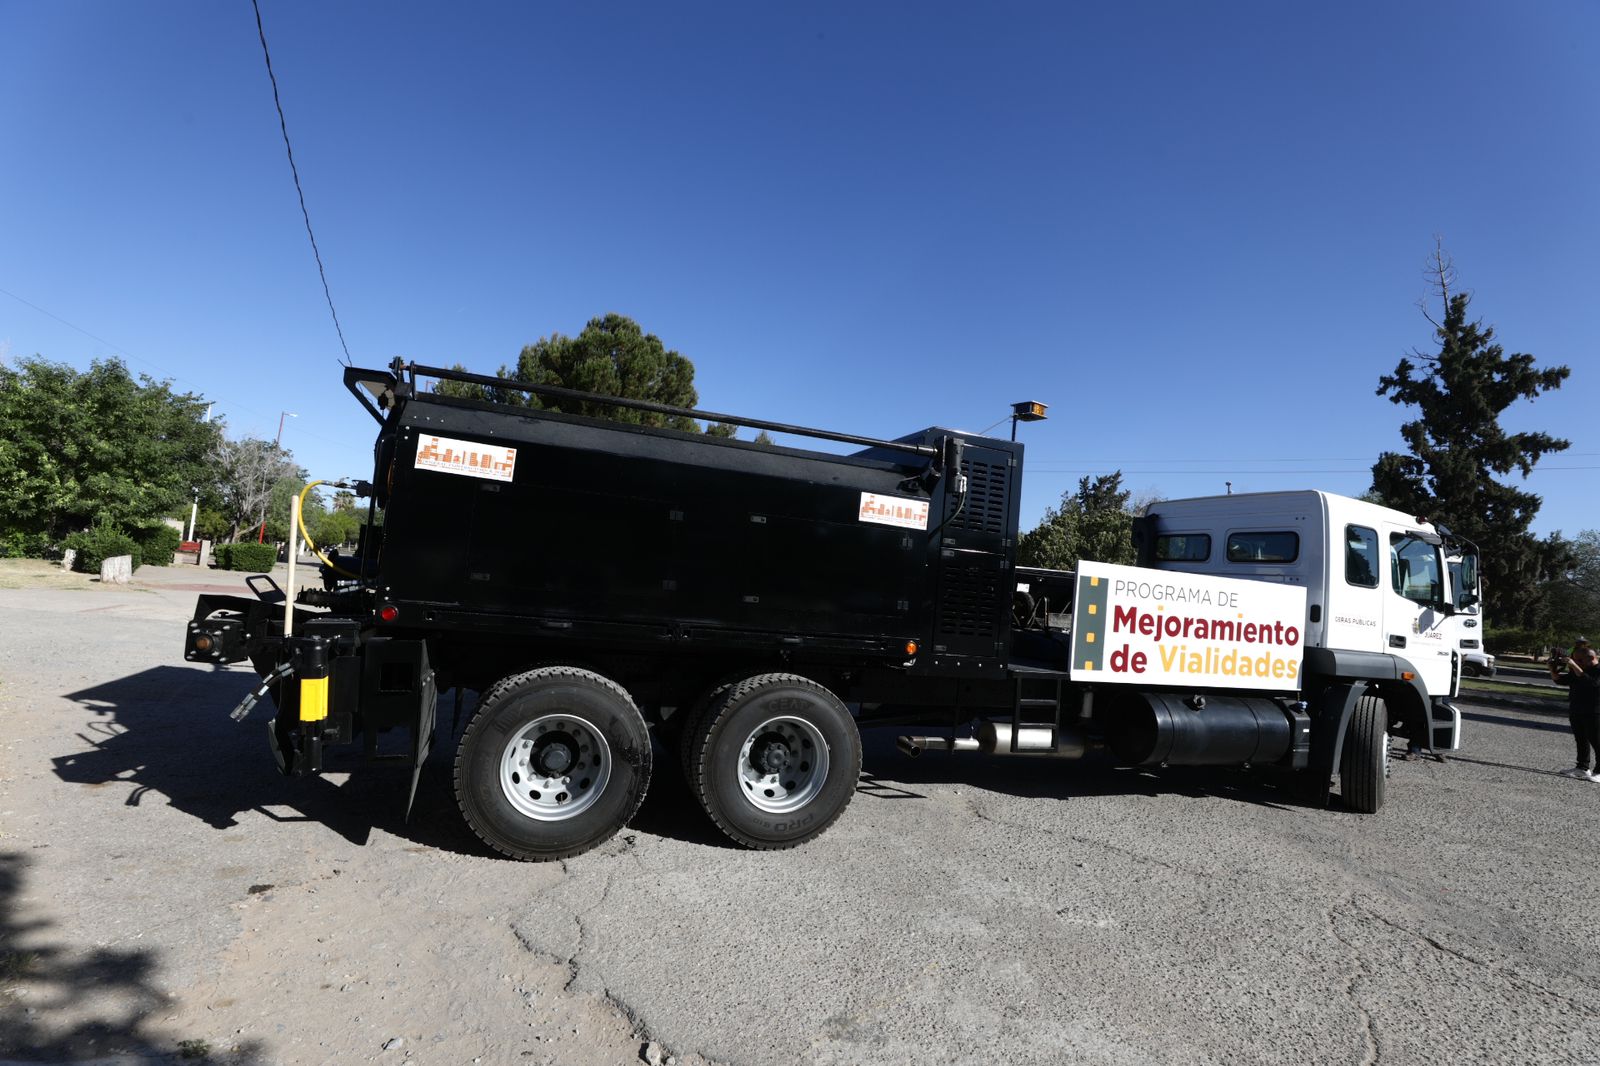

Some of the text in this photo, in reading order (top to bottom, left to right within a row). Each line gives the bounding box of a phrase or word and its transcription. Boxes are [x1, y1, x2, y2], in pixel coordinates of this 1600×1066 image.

[1115, 580, 1239, 608] PROGRAMA DE
[1113, 605, 1299, 646] Mejoramiento
[1110, 644, 1298, 679] de Vialidades
